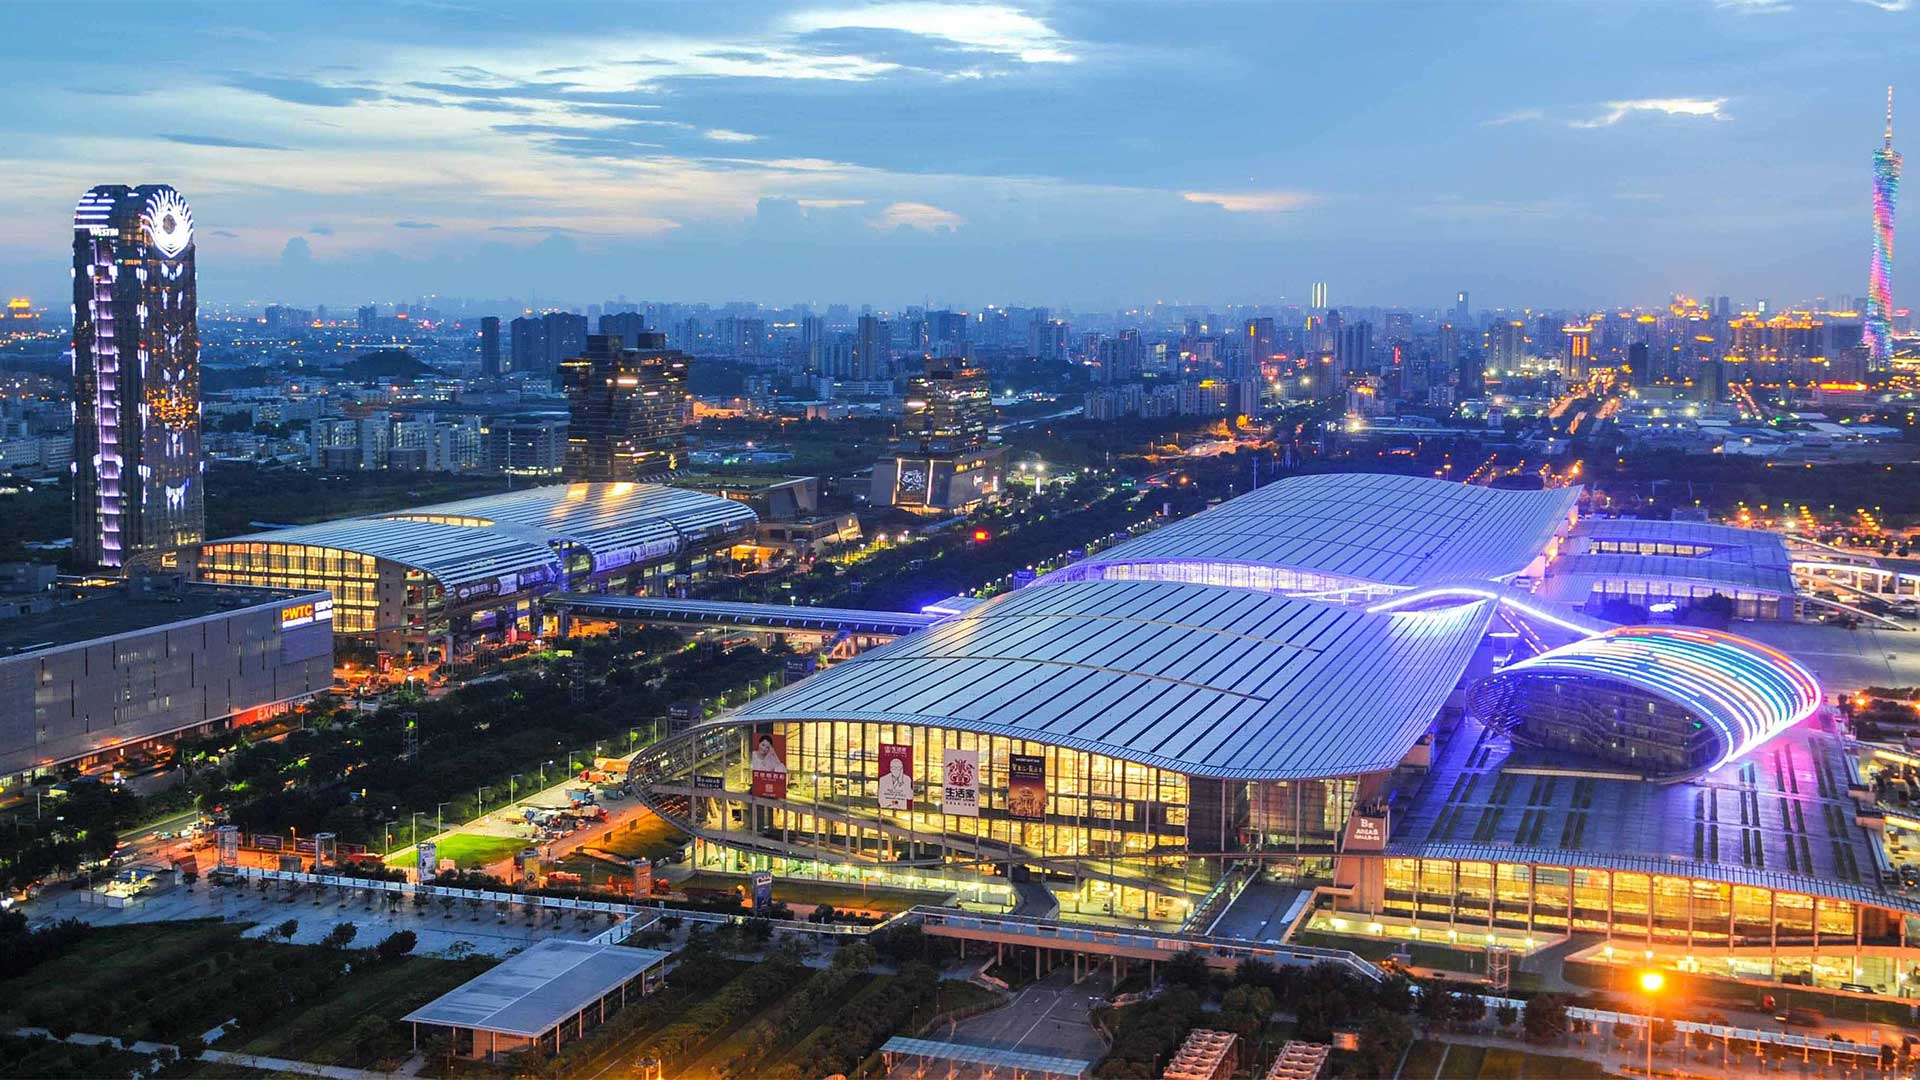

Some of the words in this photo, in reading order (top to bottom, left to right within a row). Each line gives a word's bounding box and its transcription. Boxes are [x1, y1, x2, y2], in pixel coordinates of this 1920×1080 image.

[282, 604, 313, 621] PWTC
[945, 787, 976, 799] 生活家
